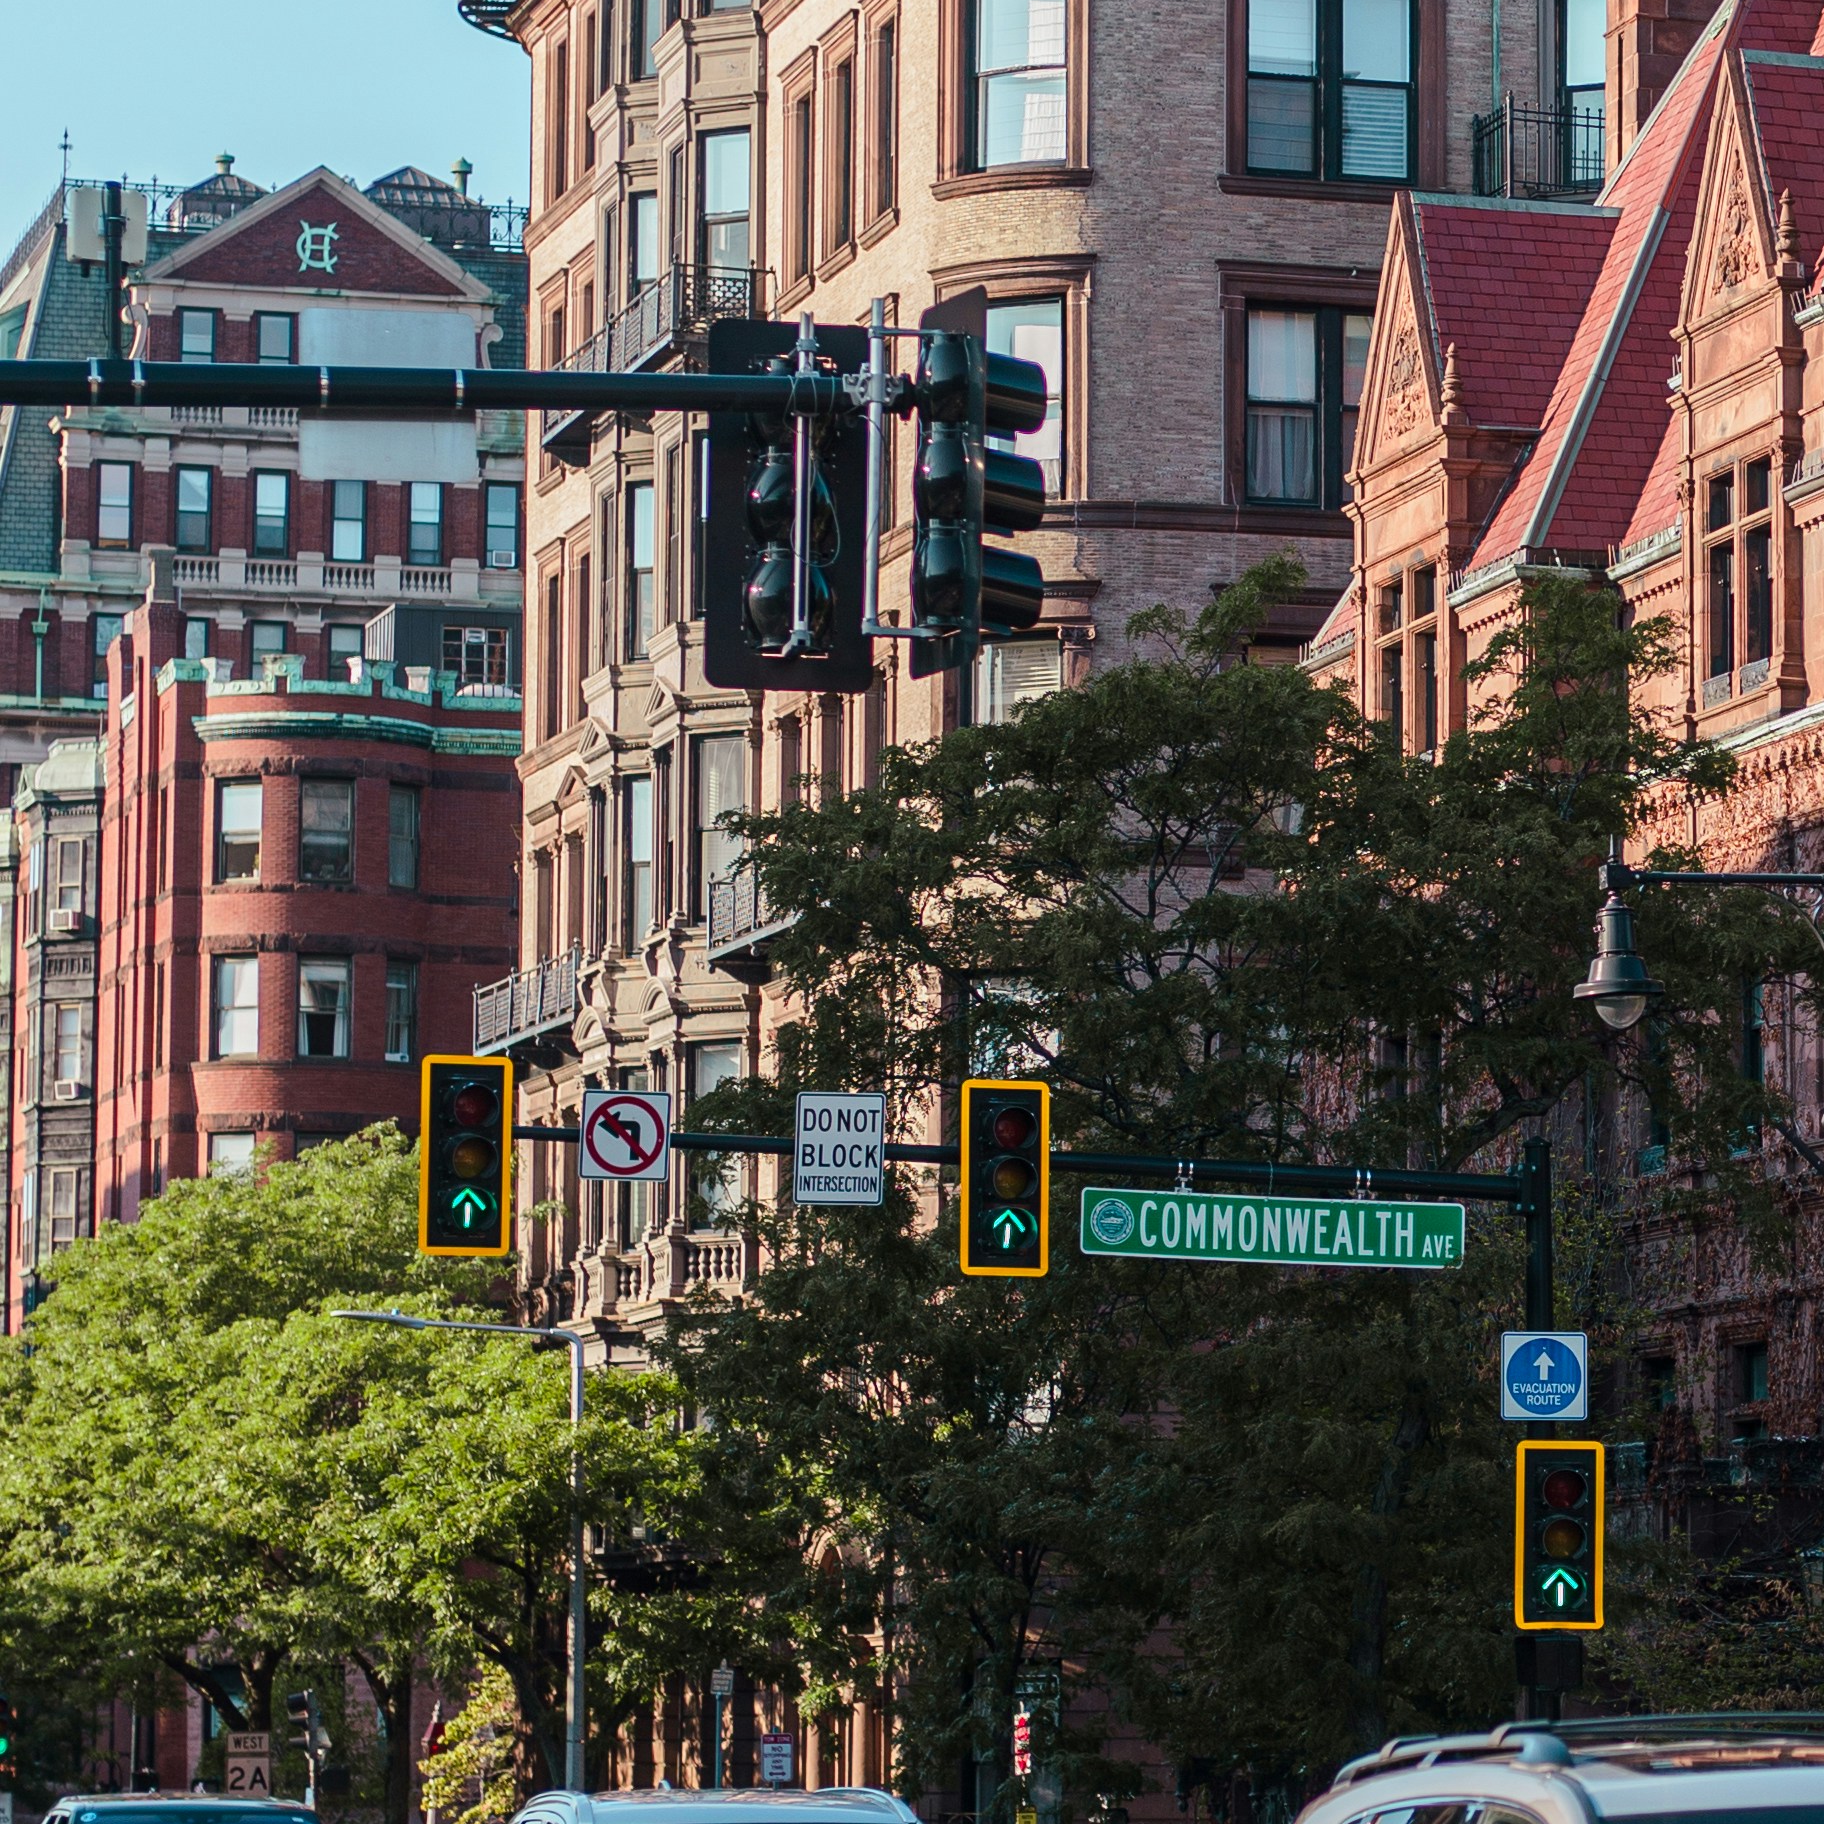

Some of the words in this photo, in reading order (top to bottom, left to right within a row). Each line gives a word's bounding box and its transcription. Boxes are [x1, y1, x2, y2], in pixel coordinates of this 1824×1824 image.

[803, 1108, 832, 1132] DO
[837, 1108, 880, 1133] NOT
[802, 1143, 878, 1168] BLOCK
[799, 1175, 877, 1193] INTERSECTION
[1140, 1200, 1414, 1257] COMMONWEALTH
[1422, 1234, 1454, 1258] AVE
[1512, 1383, 1575, 1394] EVACUATION
[1526, 1395, 1561, 1405] ROUTE
[232, 1736, 264, 1749] WEST
[229, 1765, 268, 1791] 2A
